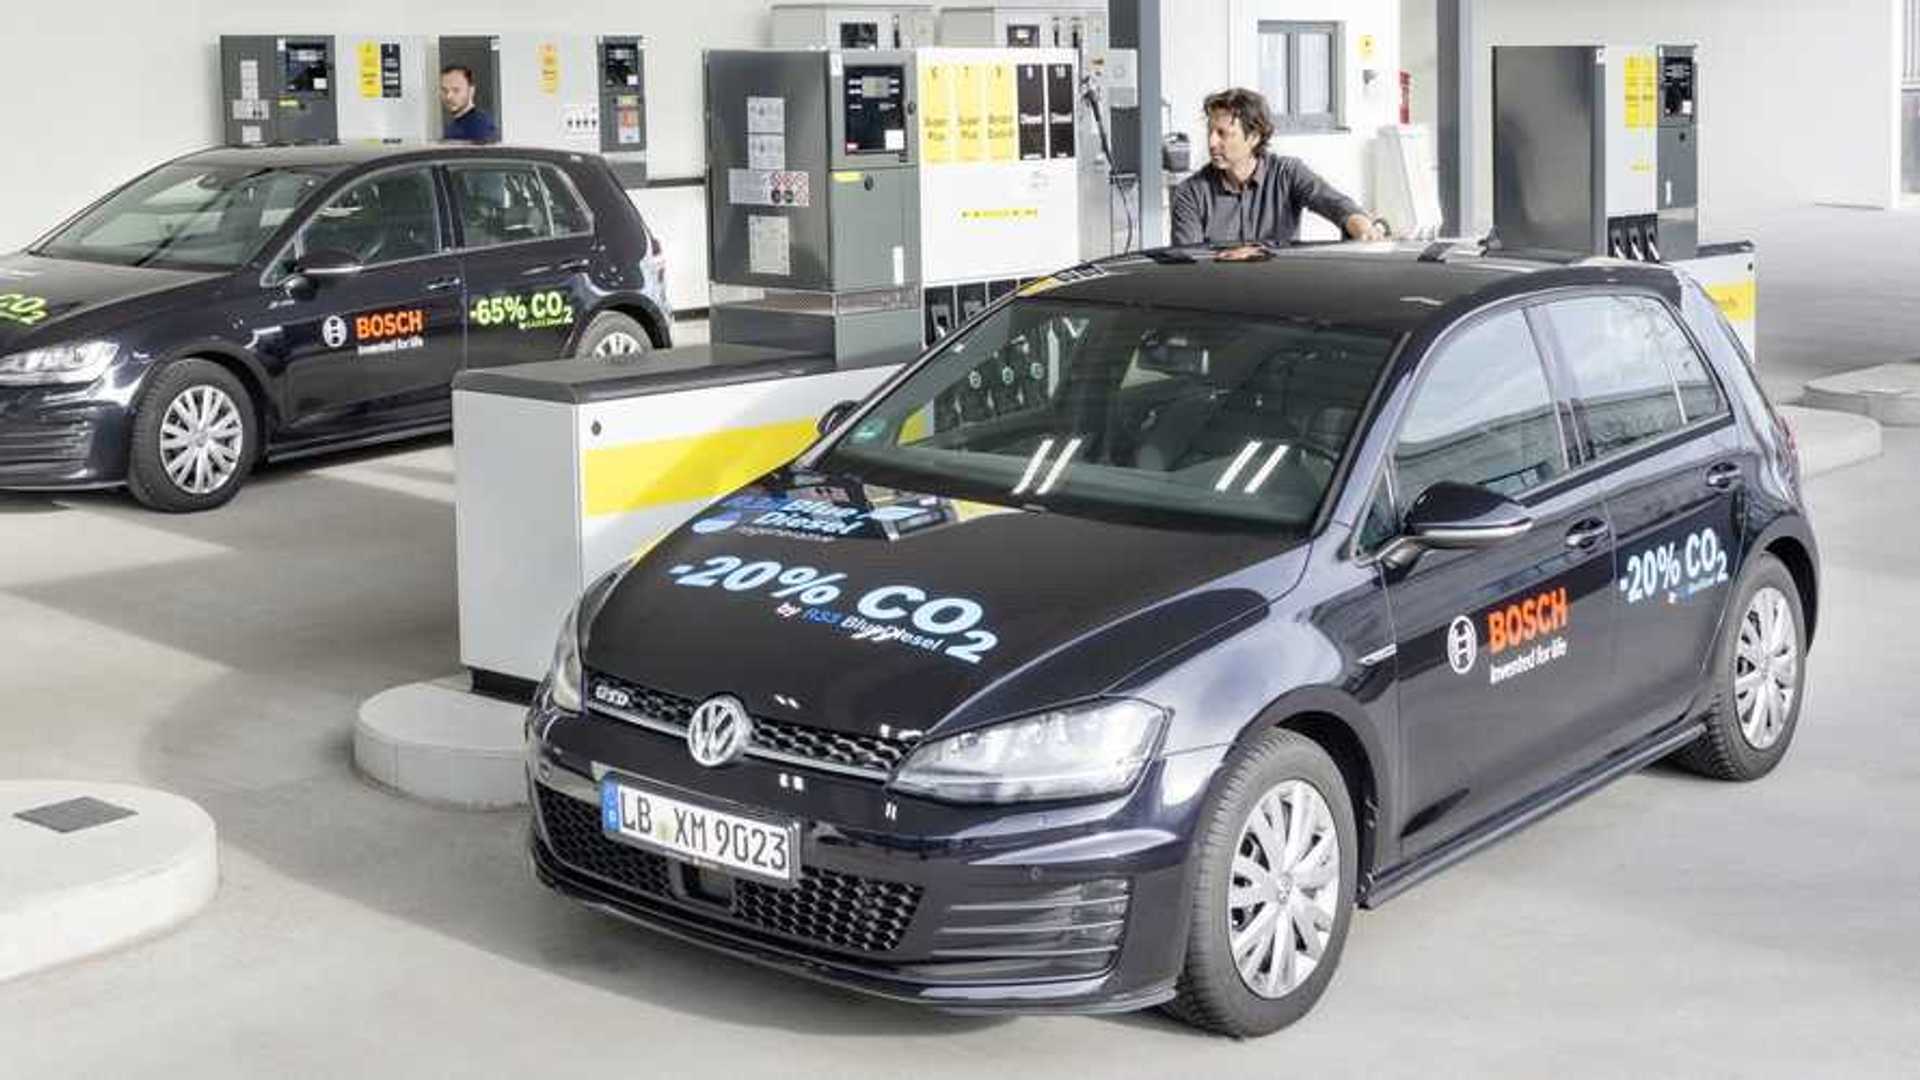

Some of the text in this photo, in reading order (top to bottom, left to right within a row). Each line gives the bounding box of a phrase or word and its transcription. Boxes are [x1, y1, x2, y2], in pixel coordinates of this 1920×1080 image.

[355, 309, 424, 339] BOSCH
[470, 295, 527, 326] -65%
[752, 511, 865, 535] Diesel
[668, 555, 848, 605] -20%
[1619, 541, 1681, 604] -20%
[1487, 586, 1568, 656] BOSCH
[620, 791, 652, 835] LB
[673, 807, 709, 853] XM
[715, 819, 788, 872] 9023
